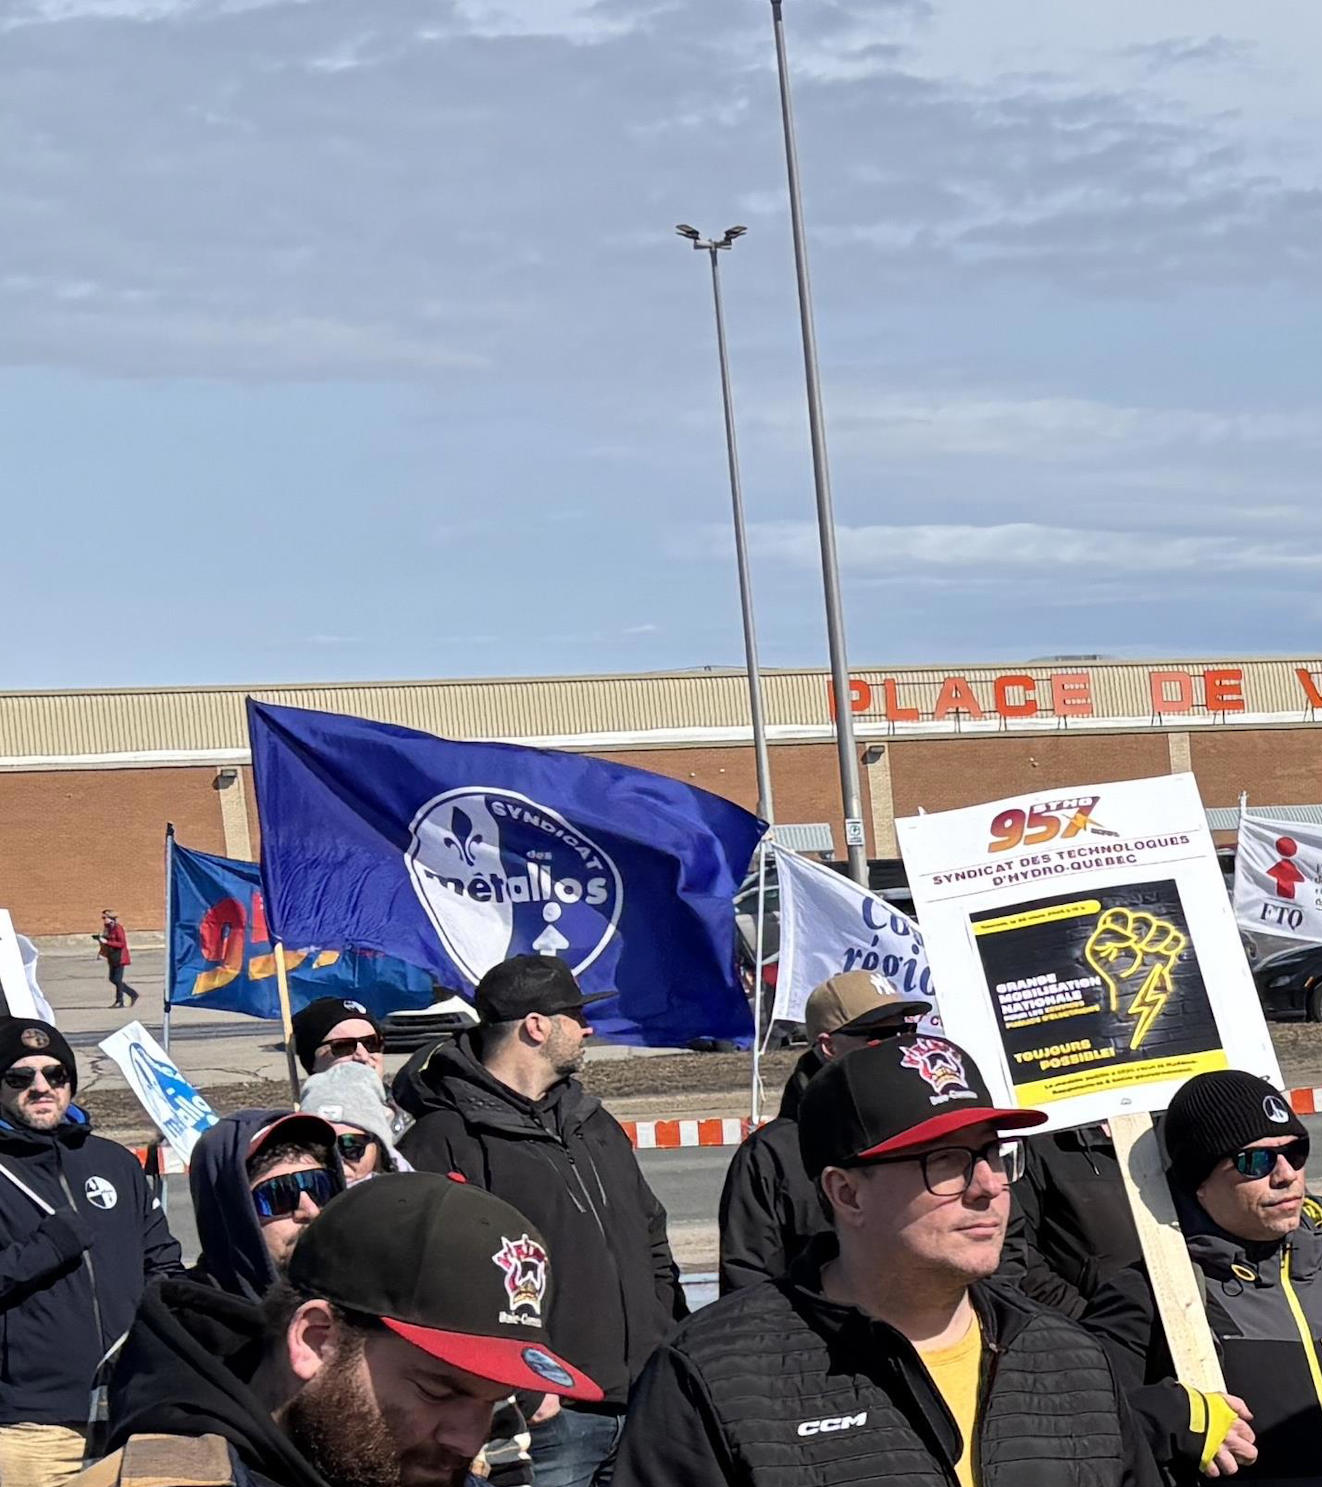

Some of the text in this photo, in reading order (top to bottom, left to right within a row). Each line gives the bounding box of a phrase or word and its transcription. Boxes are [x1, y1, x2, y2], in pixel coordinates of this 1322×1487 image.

[826, 671, 1095, 722] PLACE
[1150, 668, 1246, 712] DE
[491, 801, 604, 872] SYNDICAT
[932, 835, 1190, 885] SYNDICAT DES TECHNOLOGUES
[1260, 903, 1304, 931] FTQ
[996, 973, 1057, 994] GRANDE
[1001, 990, 1083, 1015] NATIONALE
[1013, 1038, 1092, 1065] TOUJOURS
[797, 1411, 868, 1437] CCM
